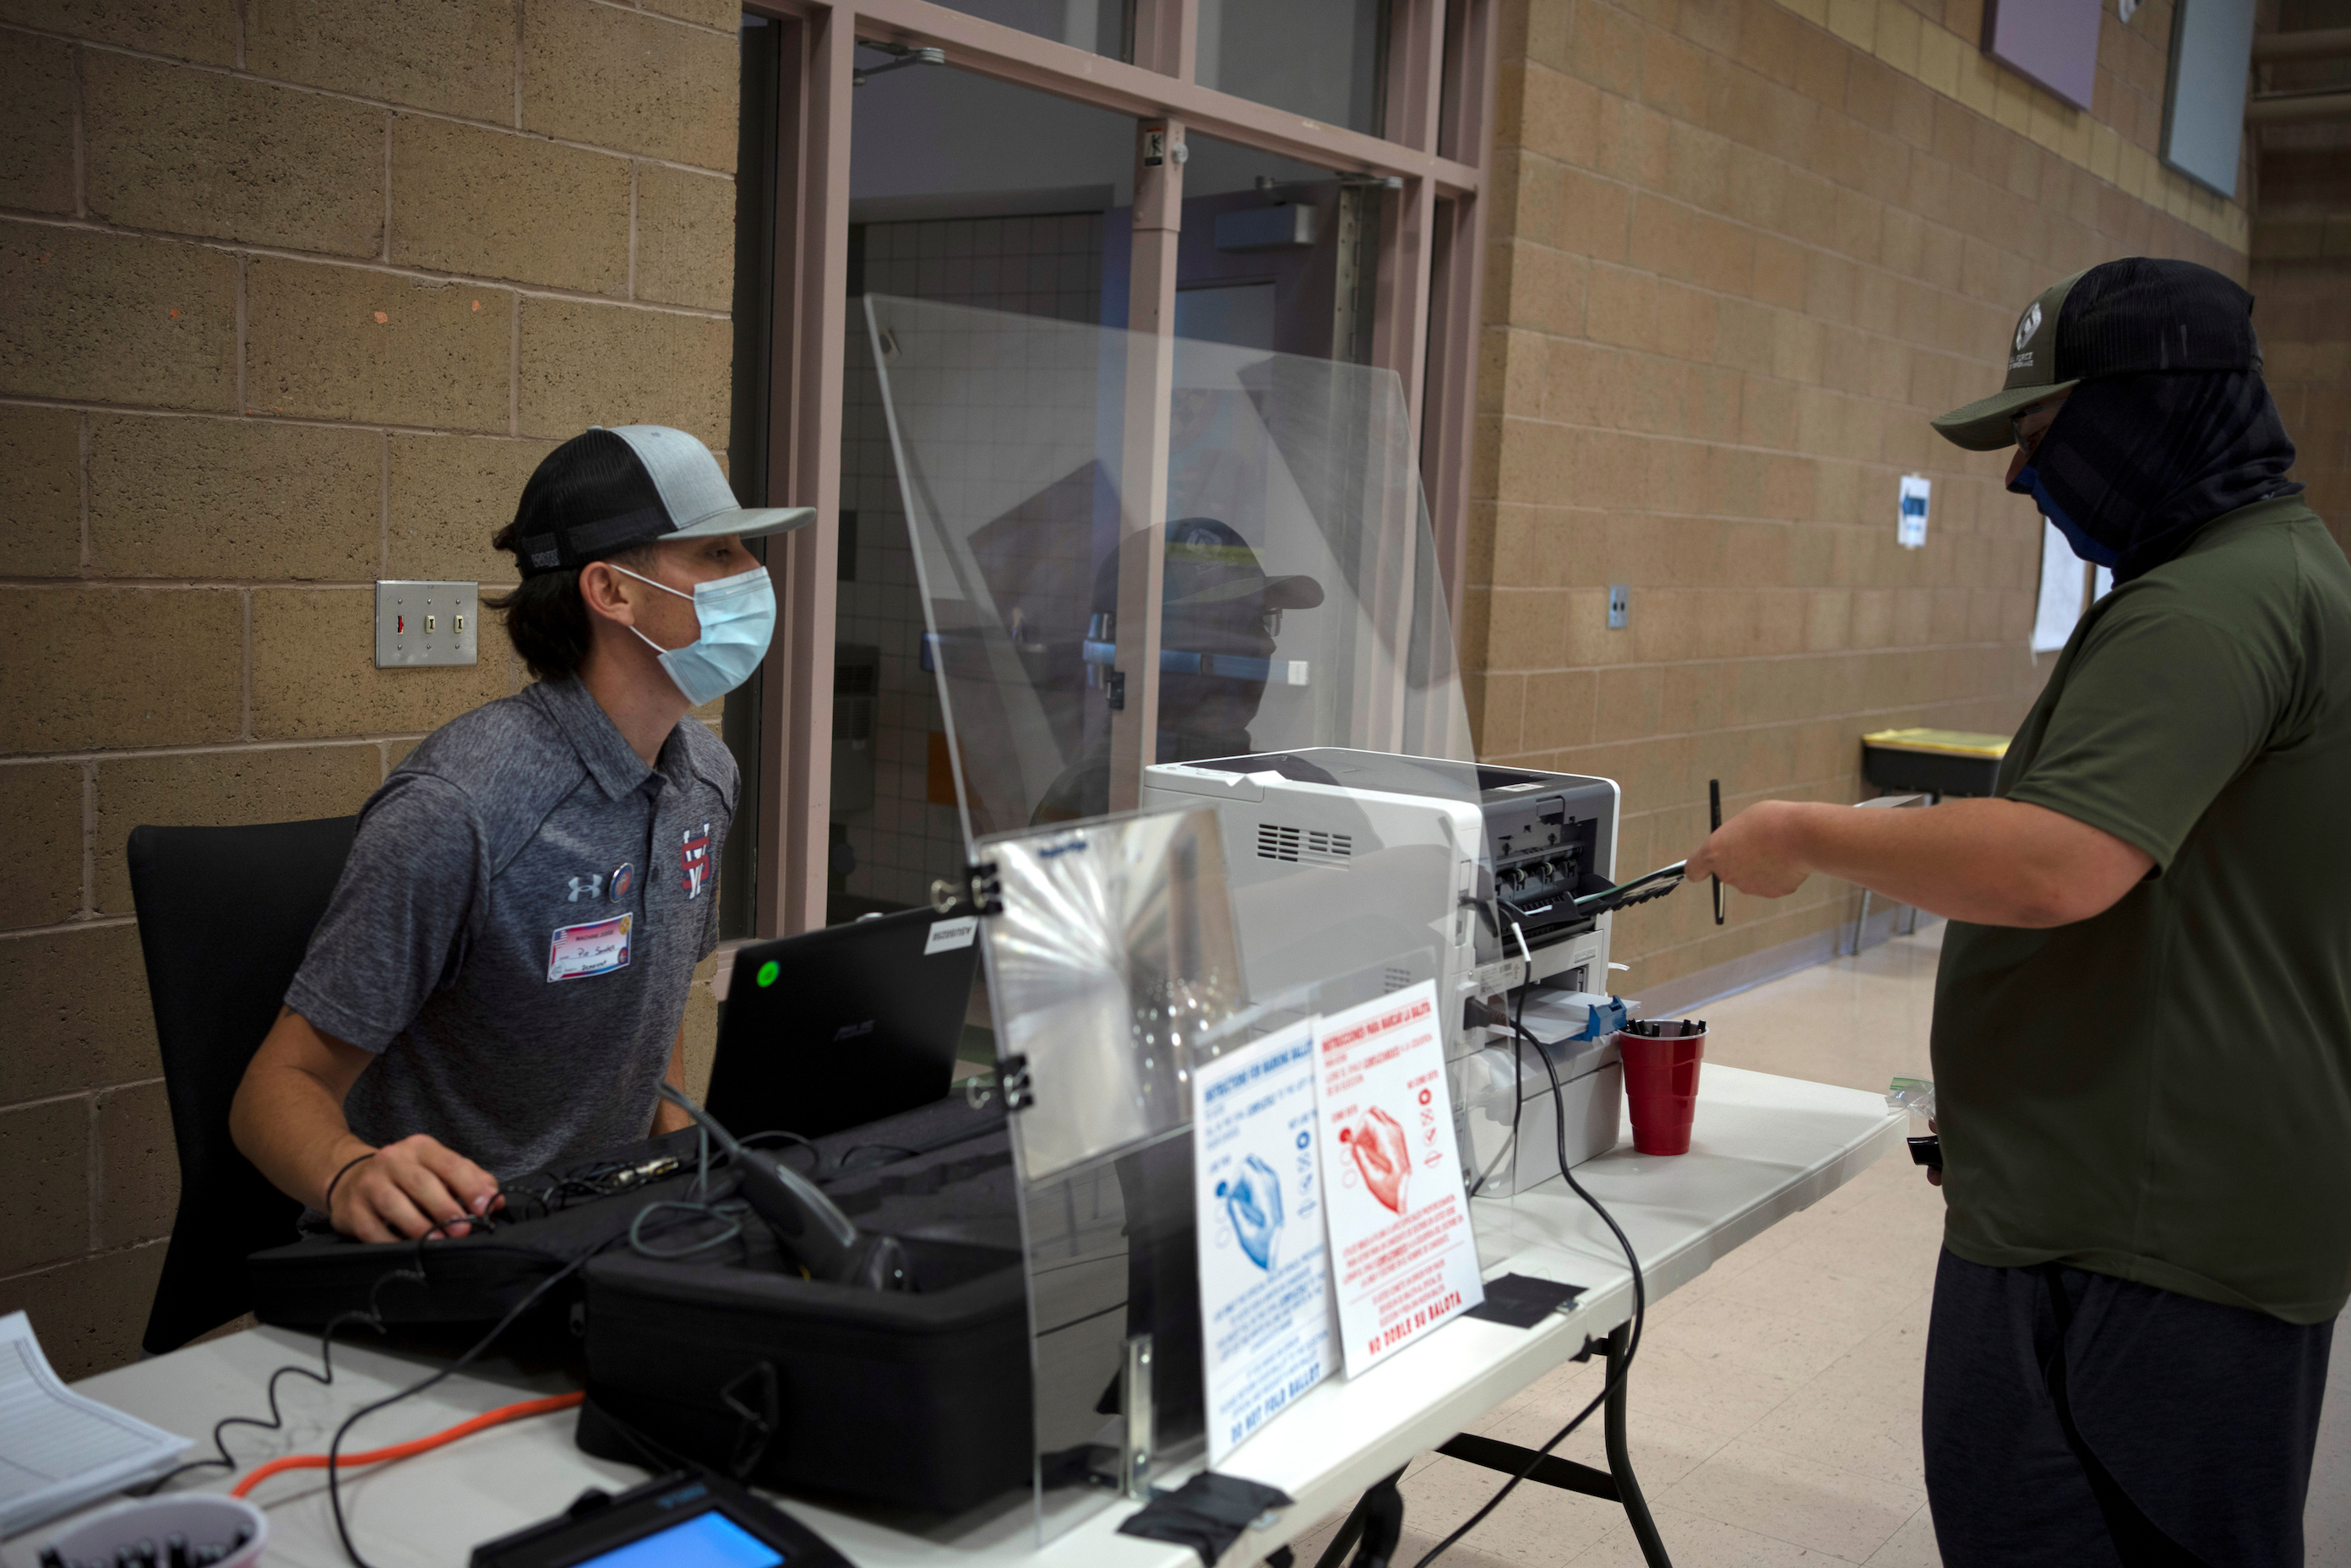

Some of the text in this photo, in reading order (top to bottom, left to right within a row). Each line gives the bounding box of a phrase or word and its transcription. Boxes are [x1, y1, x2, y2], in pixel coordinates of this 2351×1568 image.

[1368, 1289, 1463, 1356] NO DOBLE SU BALOTA
[1230, 1362, 1320, 1444] DO NOT FOLD BALLOT
